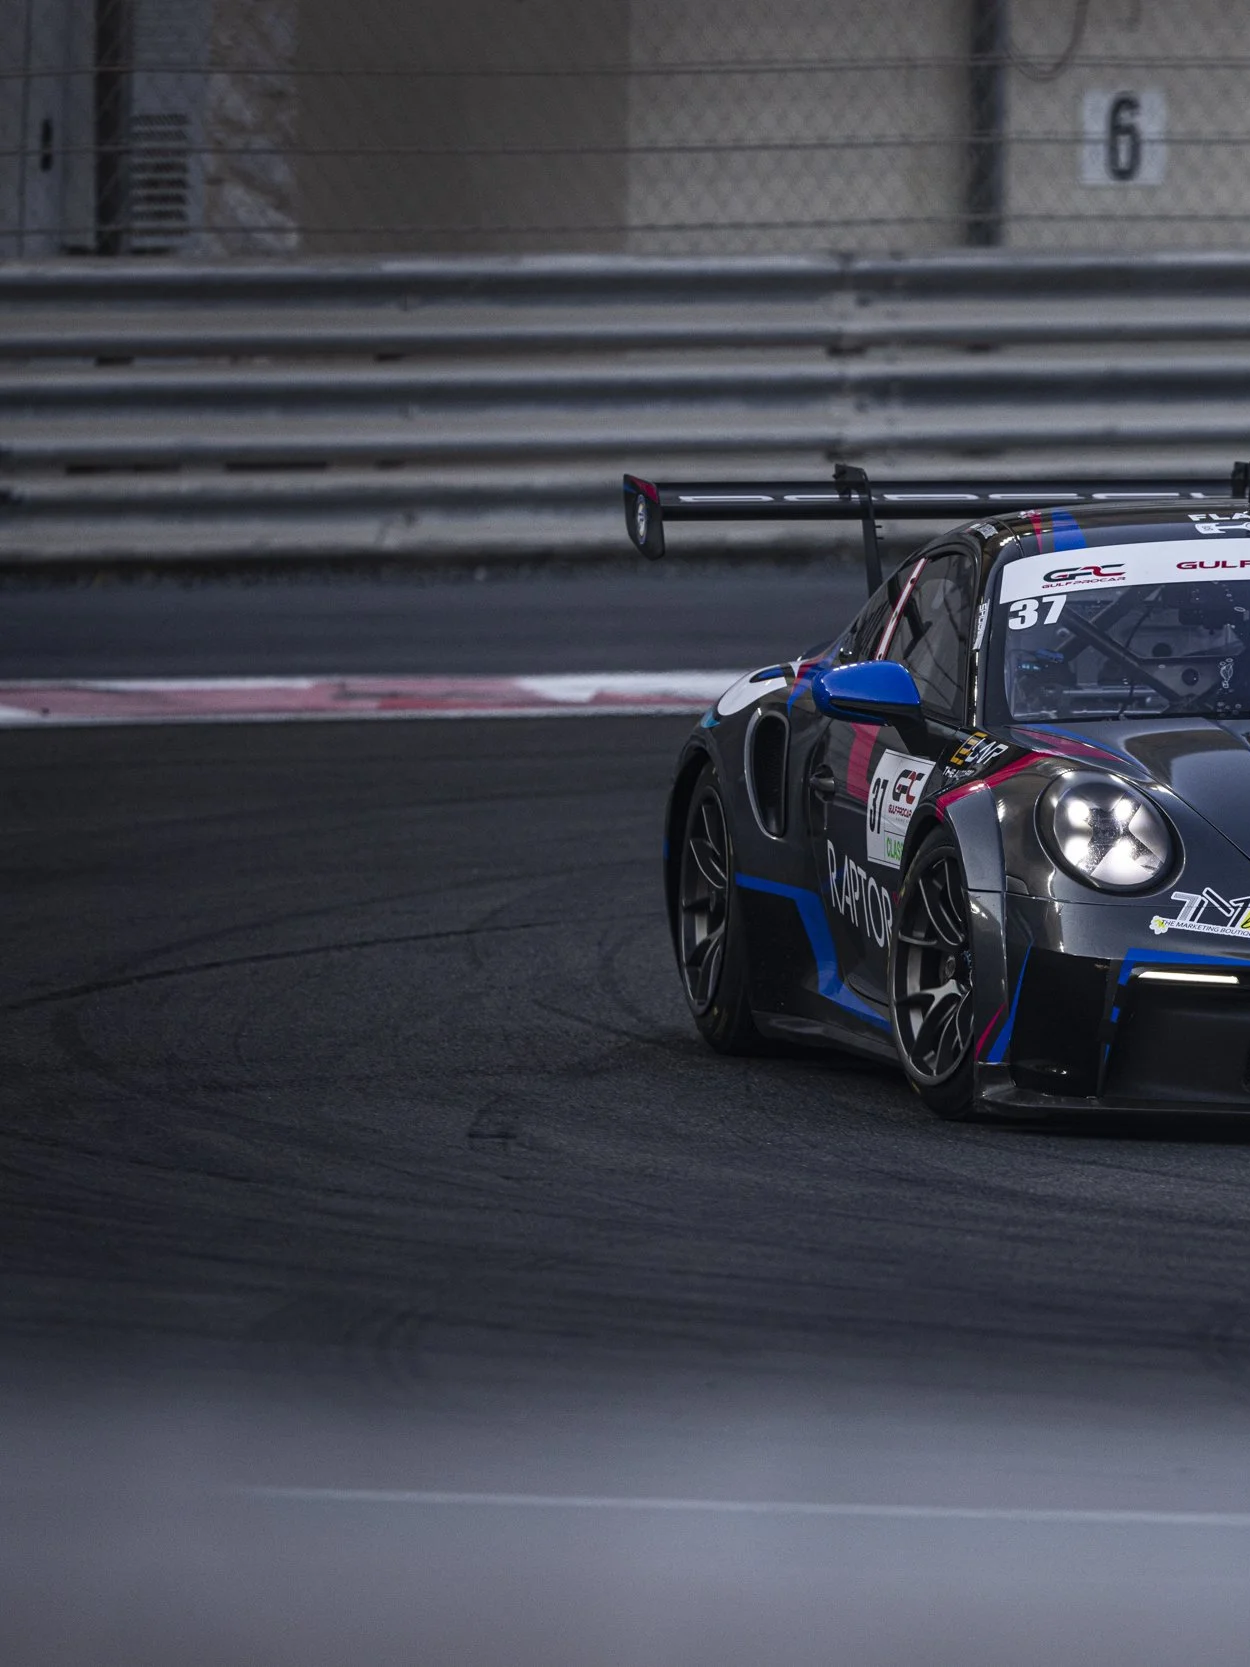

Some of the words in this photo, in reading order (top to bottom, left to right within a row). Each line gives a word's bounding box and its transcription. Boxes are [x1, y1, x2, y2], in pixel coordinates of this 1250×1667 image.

[1105, 91, 1141, 182] 6
[1008, 595, 1067, 630] 37
[870, 777, 889, 834] 37
[886, 836, 904, 861] CLAS
[827, 839, 893, 958] RAPTOR
[1176, 921, 1220, 933] MARKETING
